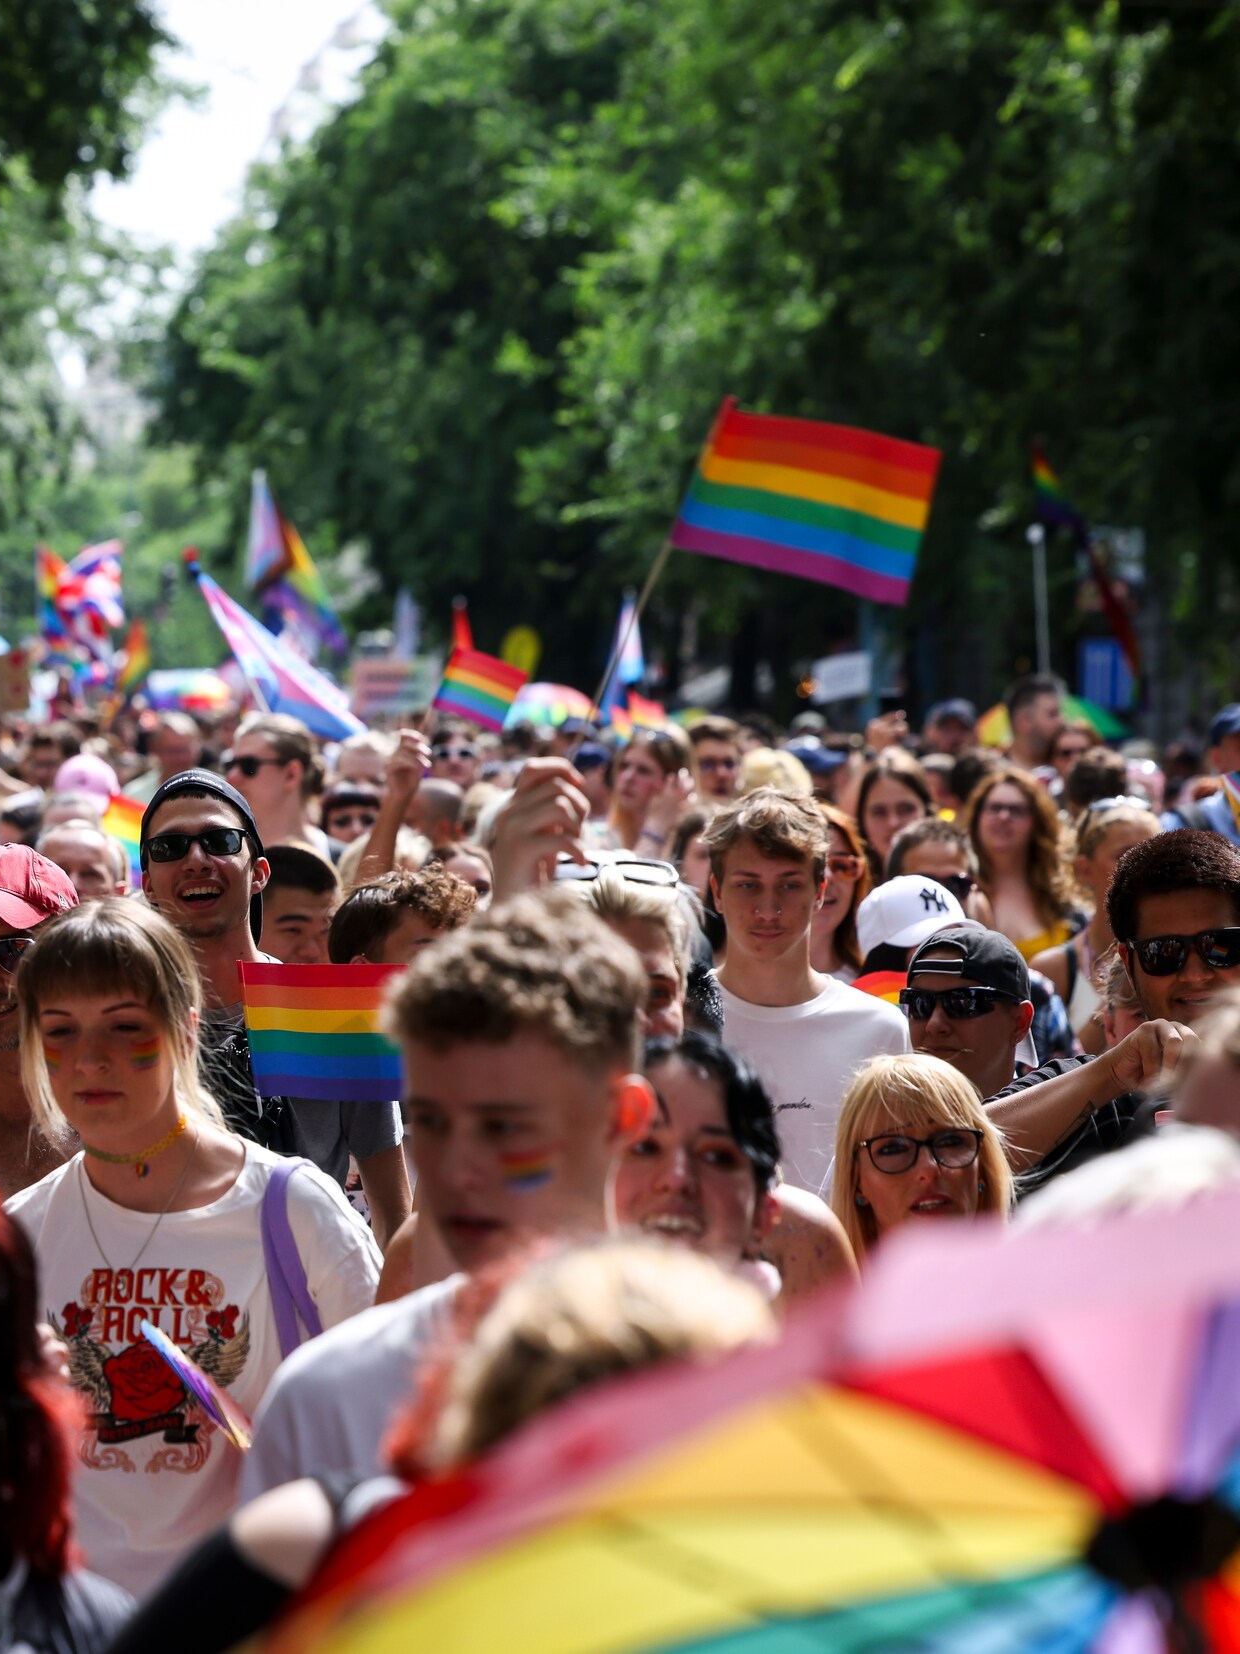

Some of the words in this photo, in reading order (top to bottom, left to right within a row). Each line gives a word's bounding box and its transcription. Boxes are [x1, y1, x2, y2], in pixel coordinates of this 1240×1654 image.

[919, 888, 949, 911] NY
[101, 1306, 193, 1344] ROLL
[101, 1425, 140, 1440] RETRO
